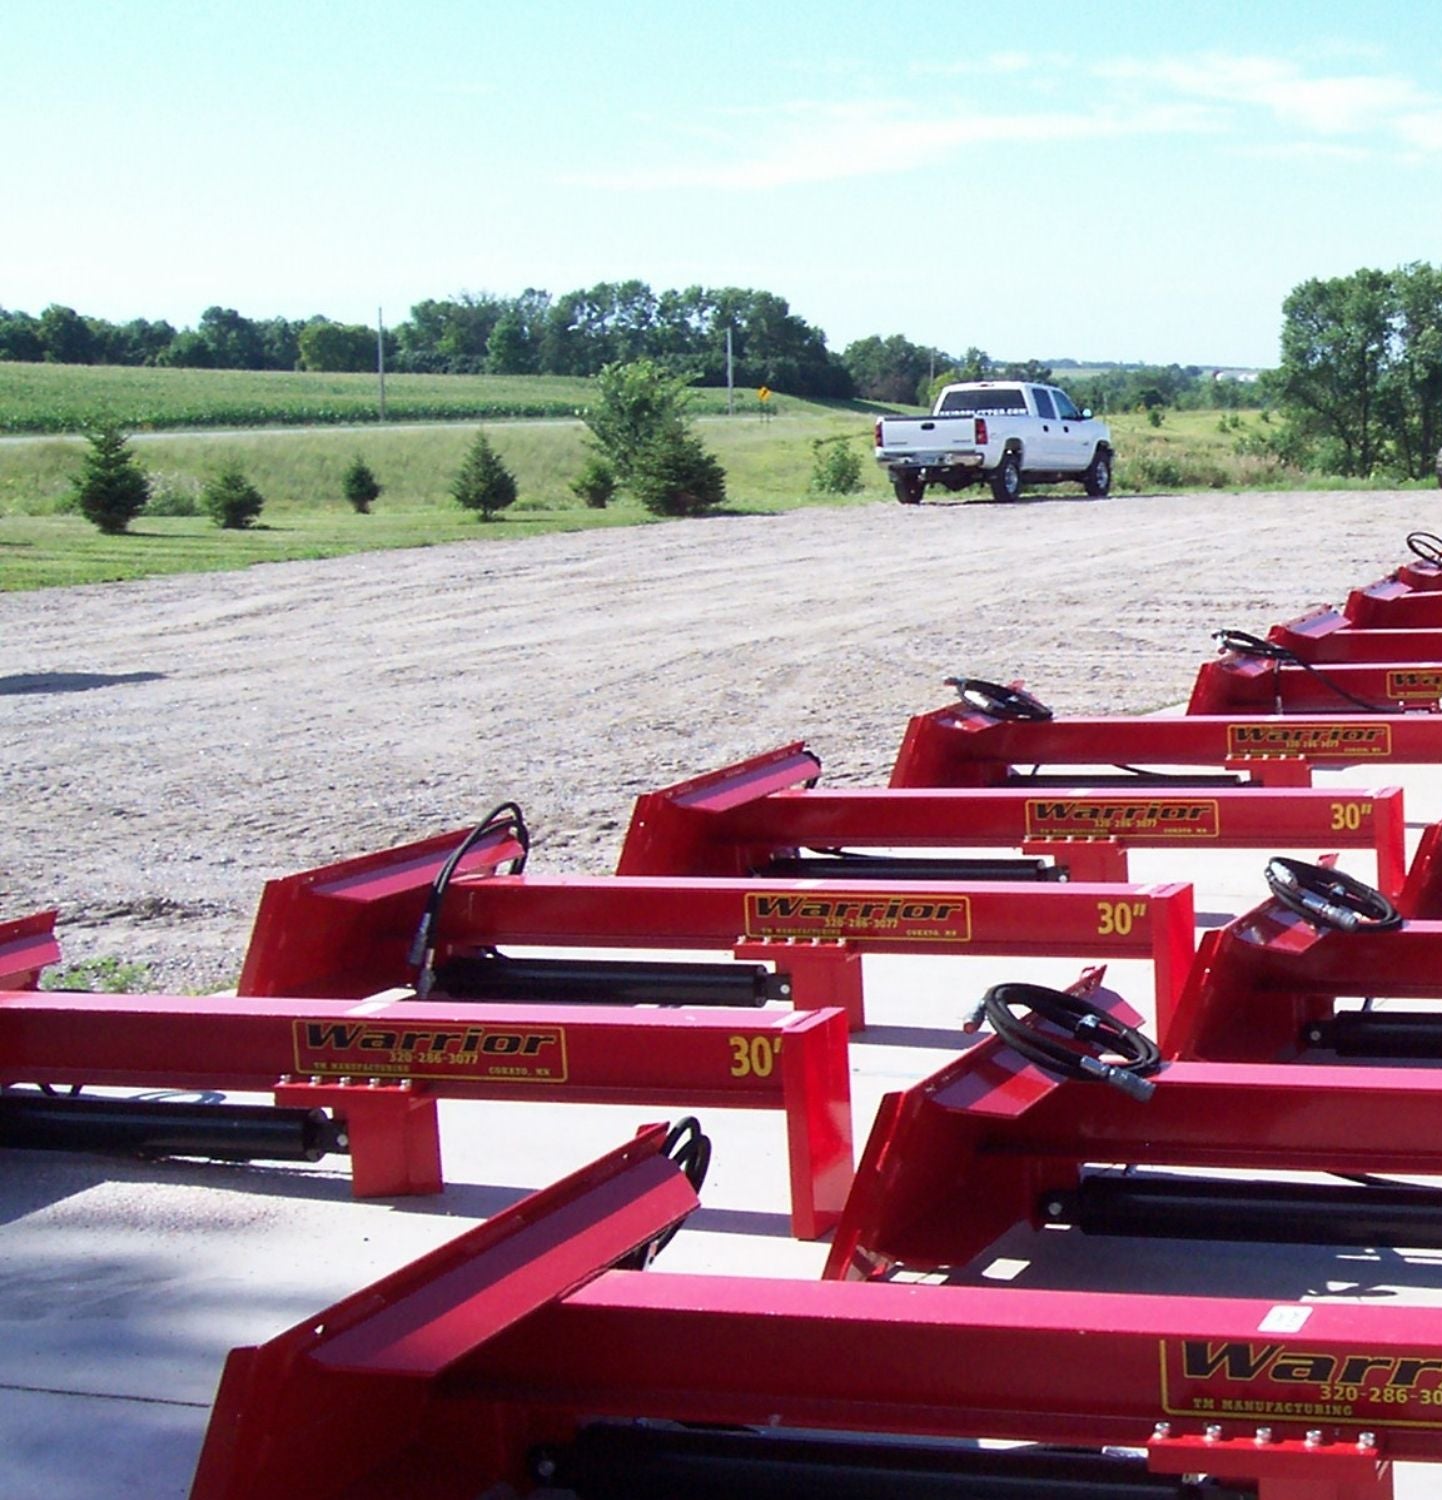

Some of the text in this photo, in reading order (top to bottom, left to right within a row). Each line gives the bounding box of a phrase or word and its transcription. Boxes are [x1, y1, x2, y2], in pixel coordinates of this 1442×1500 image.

[1235, 728, 1386, 742] Warrior
[1034, 802, 1211, 821] Warrior
[1331, 804, 1372, 830] 30"
[755, 896, 962, 921] Warrior
[825, 918, 898, 928] 320-286-3077
[1097, 903, 1147, 934] 30"
[304, 1023, 556, 1055] Warrior
[390, 1053, 478, 1064] 320-286-3077
[1193, 1399, 1211, 1409] TM
[1223, 1399, 1352, 1416] MANUFACTURING
